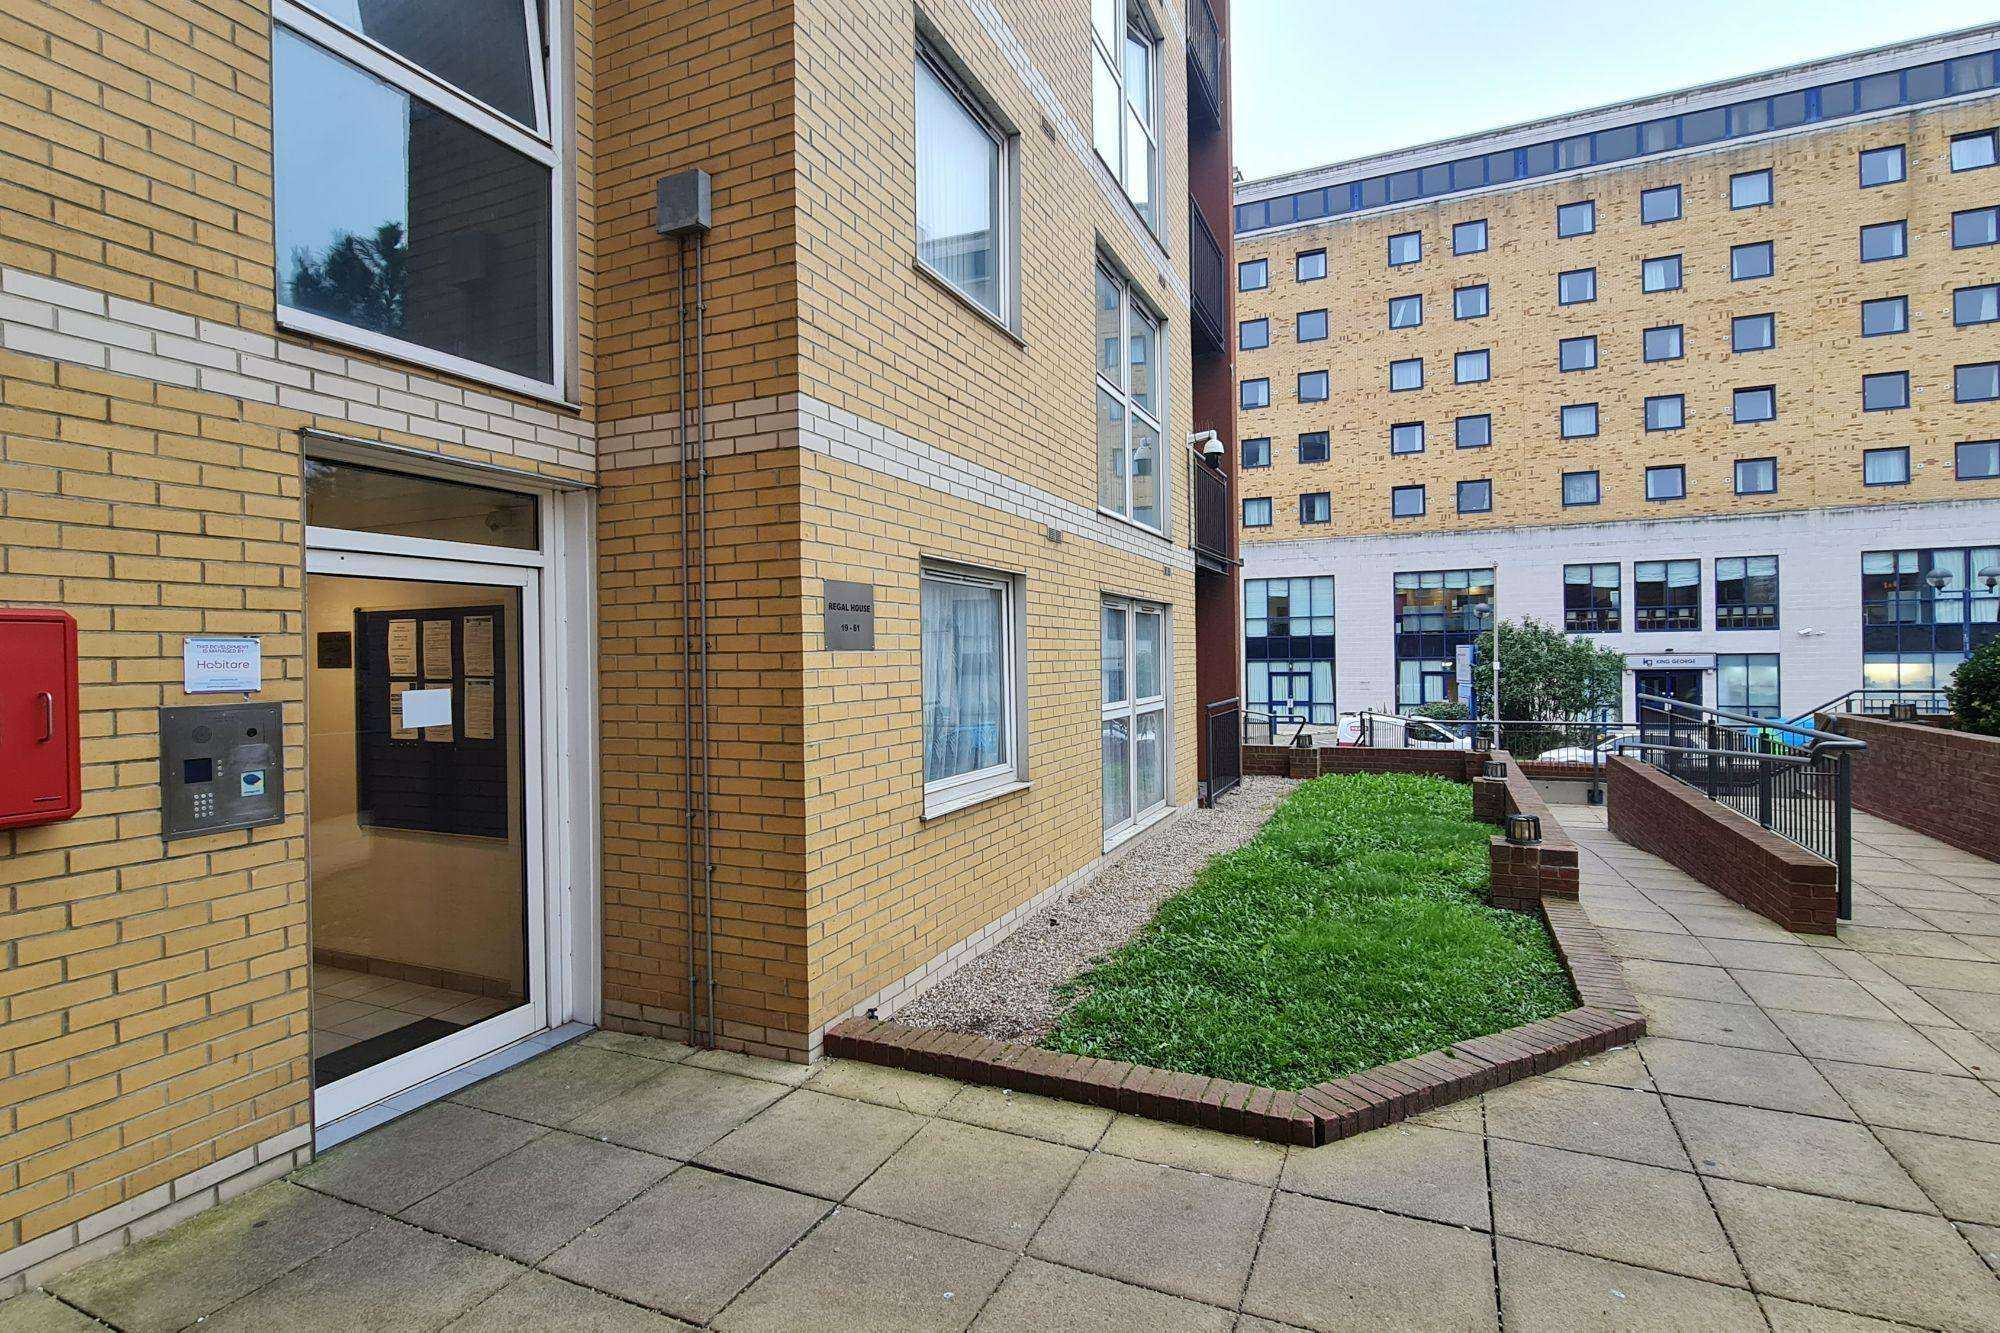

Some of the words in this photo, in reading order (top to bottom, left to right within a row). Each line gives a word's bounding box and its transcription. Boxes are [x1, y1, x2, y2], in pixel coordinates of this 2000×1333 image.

[828, 602, 849, 612] REGAL
[850, 604, 871, 613] HOUSE
[841, 624, 849, 632] 19
[197, 659, 250, 670] Habitare
